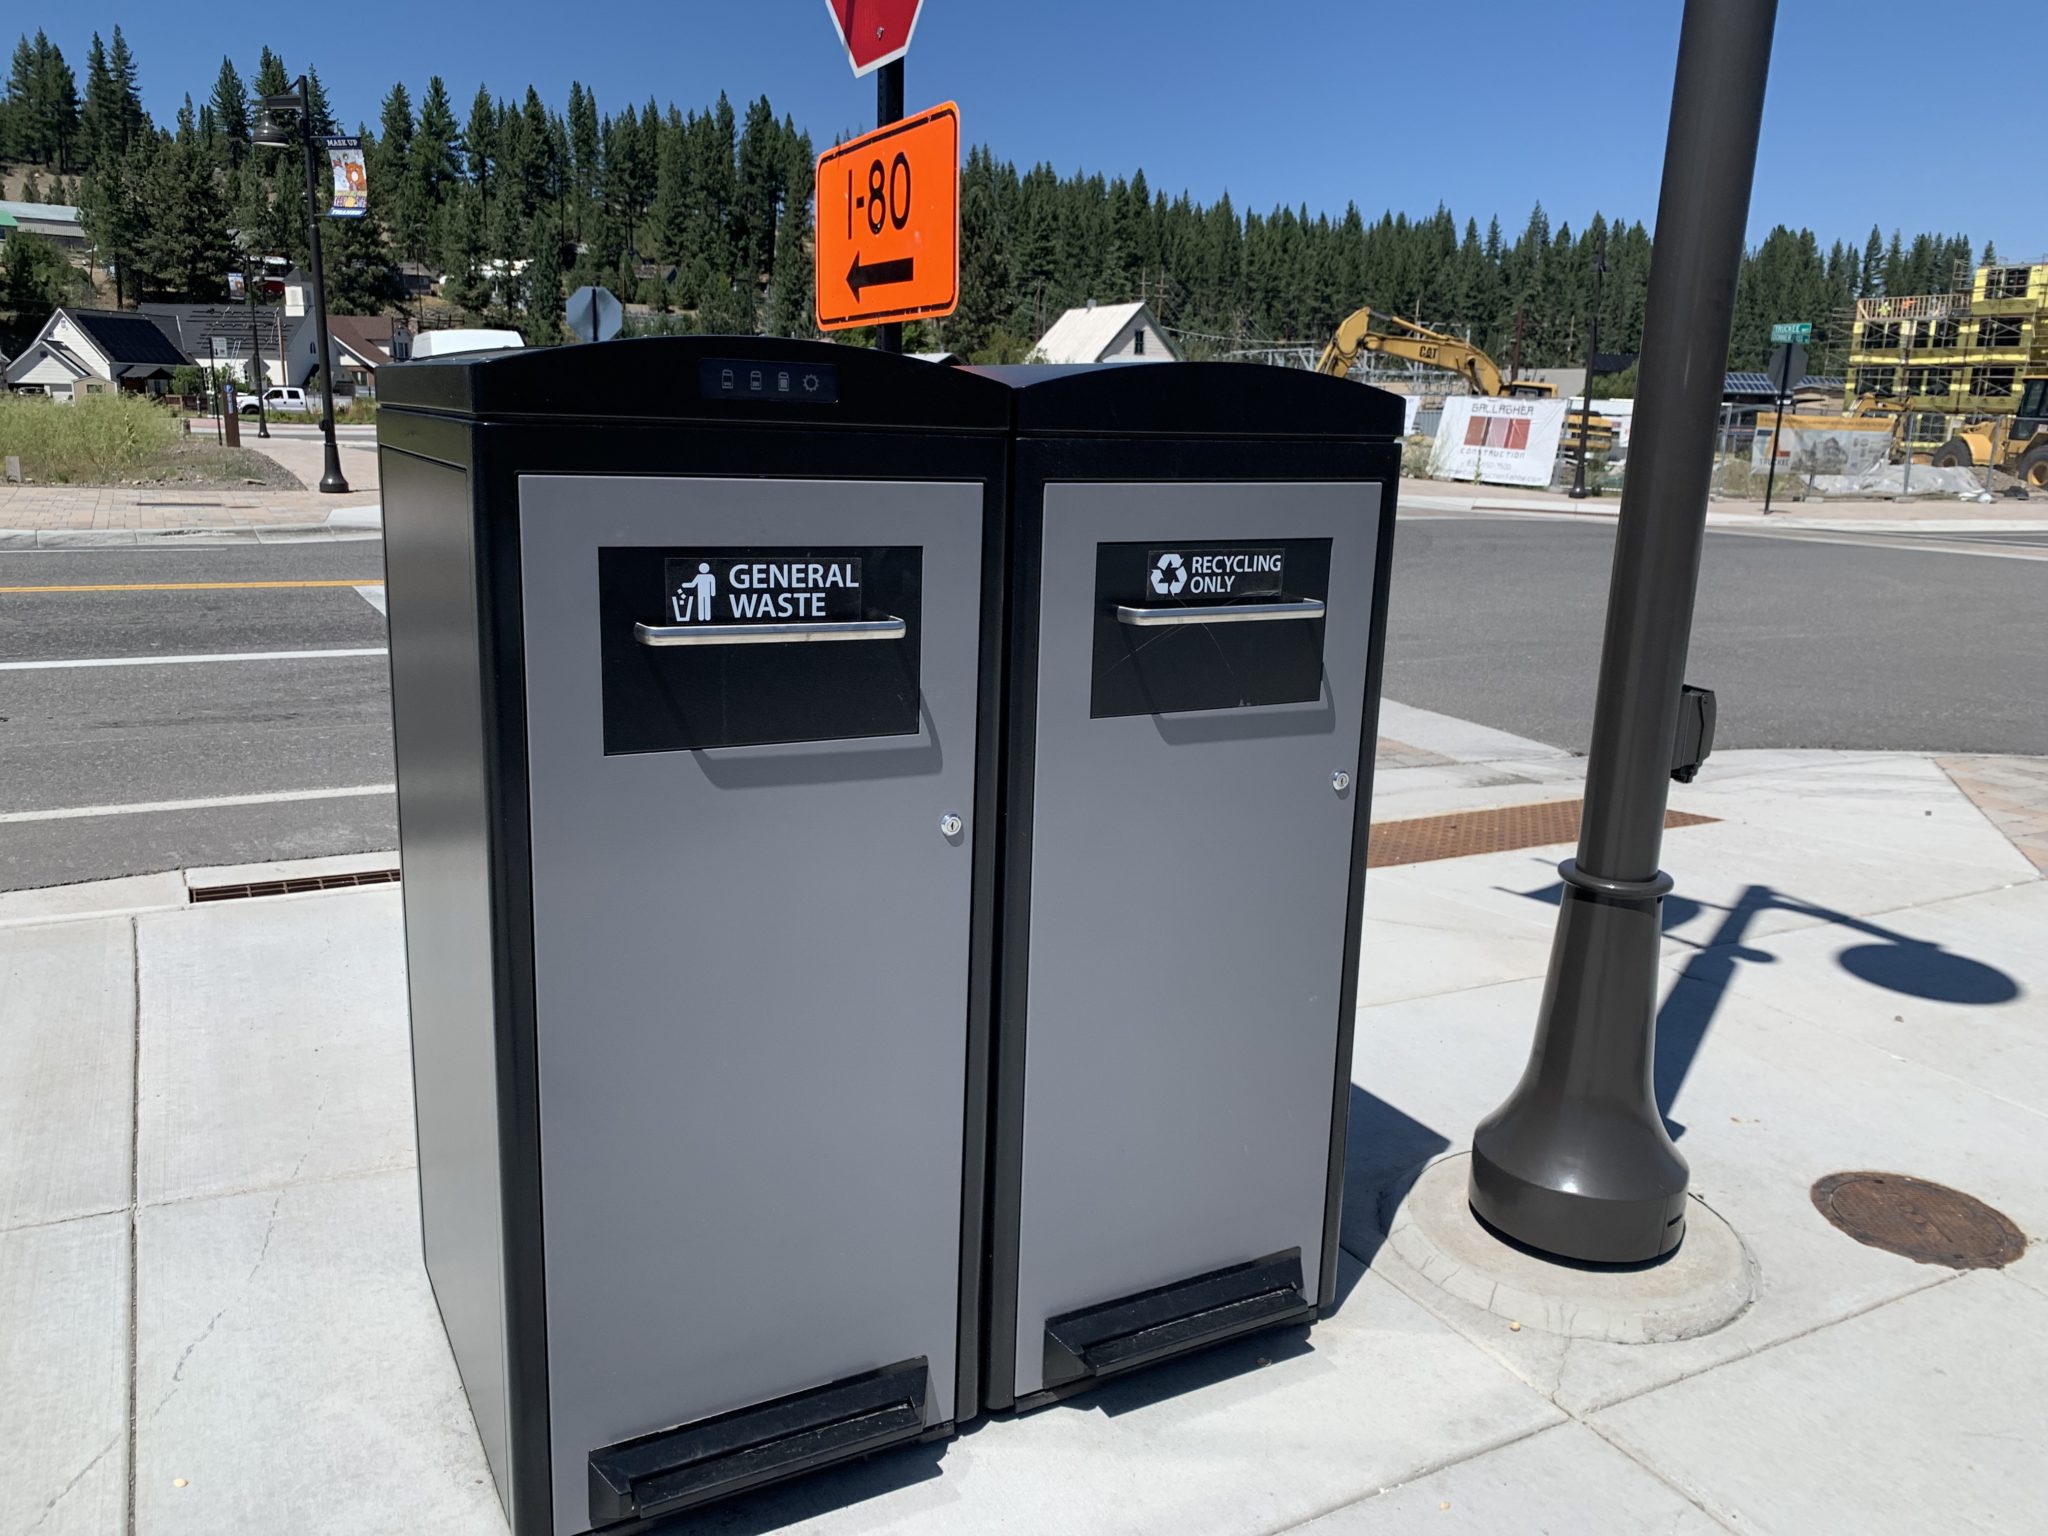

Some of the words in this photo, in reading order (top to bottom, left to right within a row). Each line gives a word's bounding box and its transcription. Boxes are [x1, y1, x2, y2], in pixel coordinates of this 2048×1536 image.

[847, 151, 911, 240] I-80
[1419, 345, 1437, 359] CAT
[1471, 403, 1534, 416] GALLAGHER
[1191, 554, 1282, 575] RECYCLING
[728, 562, 860, 590] GENERAL
[1190, 575, 1236, 594] ONLY
[728, 592, 827, 619] WASTE
